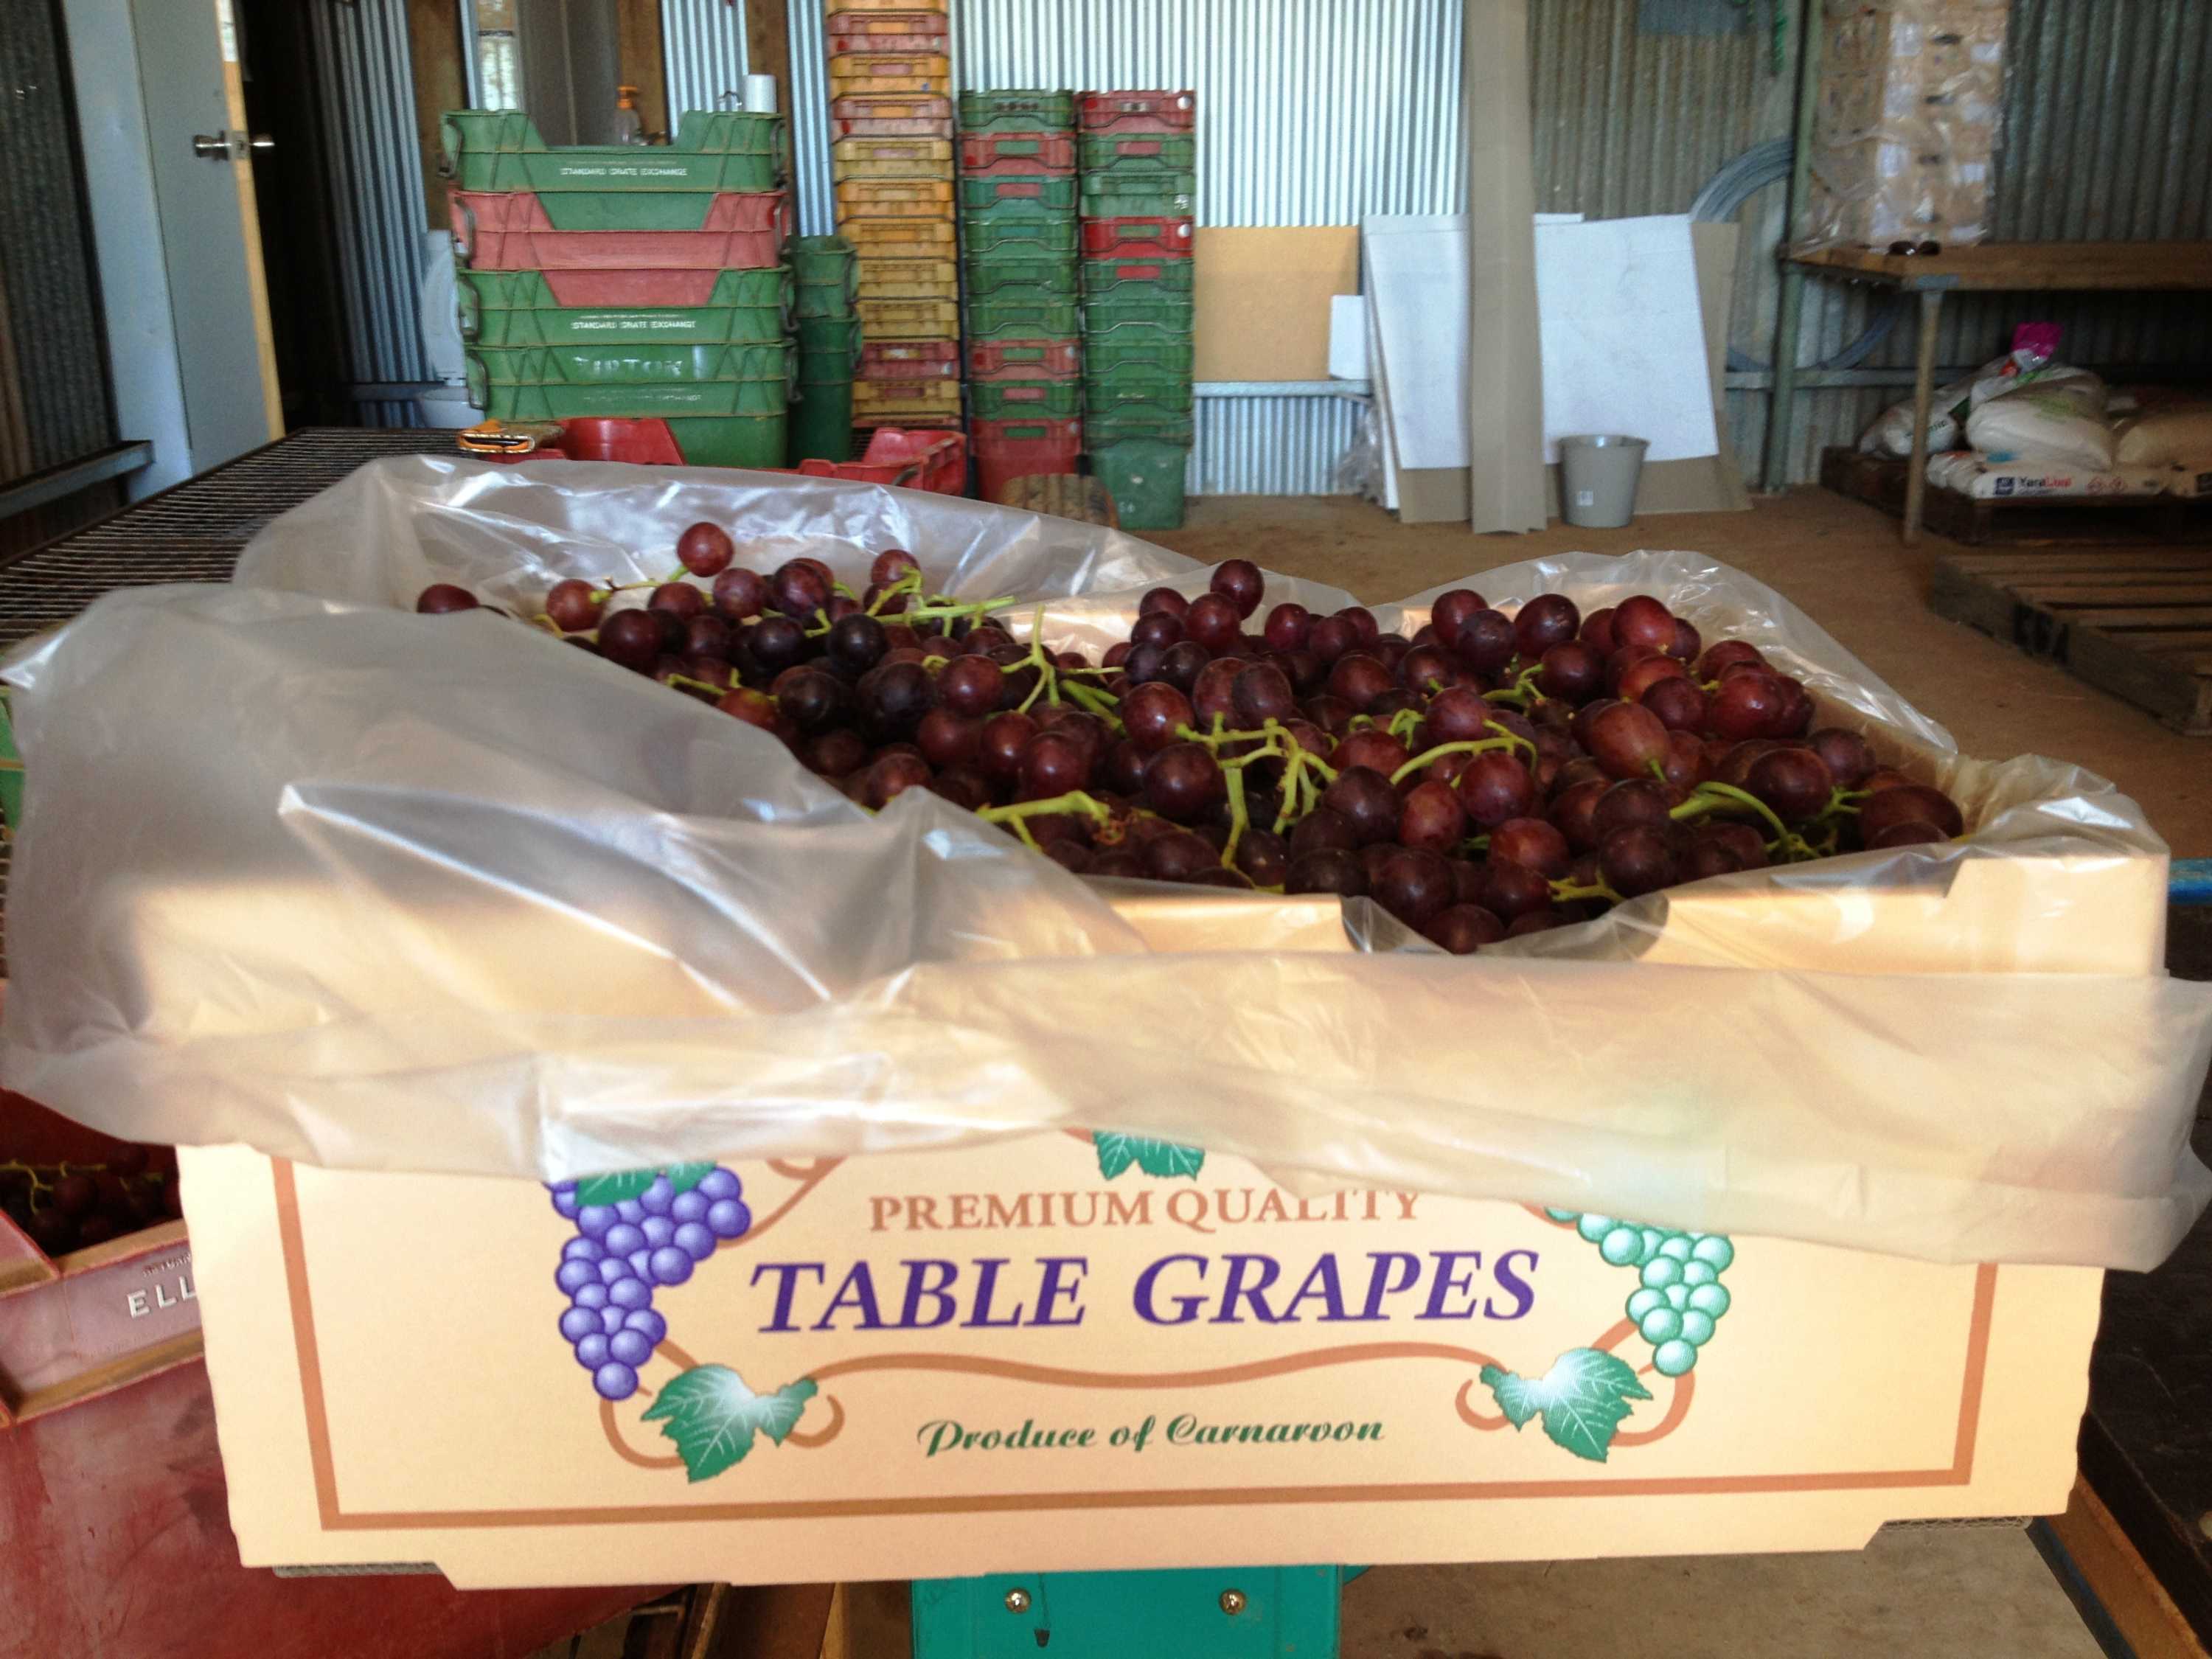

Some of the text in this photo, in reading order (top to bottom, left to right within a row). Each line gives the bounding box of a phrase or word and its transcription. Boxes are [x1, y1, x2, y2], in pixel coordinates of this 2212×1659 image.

[868, 1187, 1419, 1234] PREMIUM QUALITY
[749, 1249, 1540, 1333] TABLE GRAPES
[917, 1413, 1385, 1458] Produce of Carnarvon
